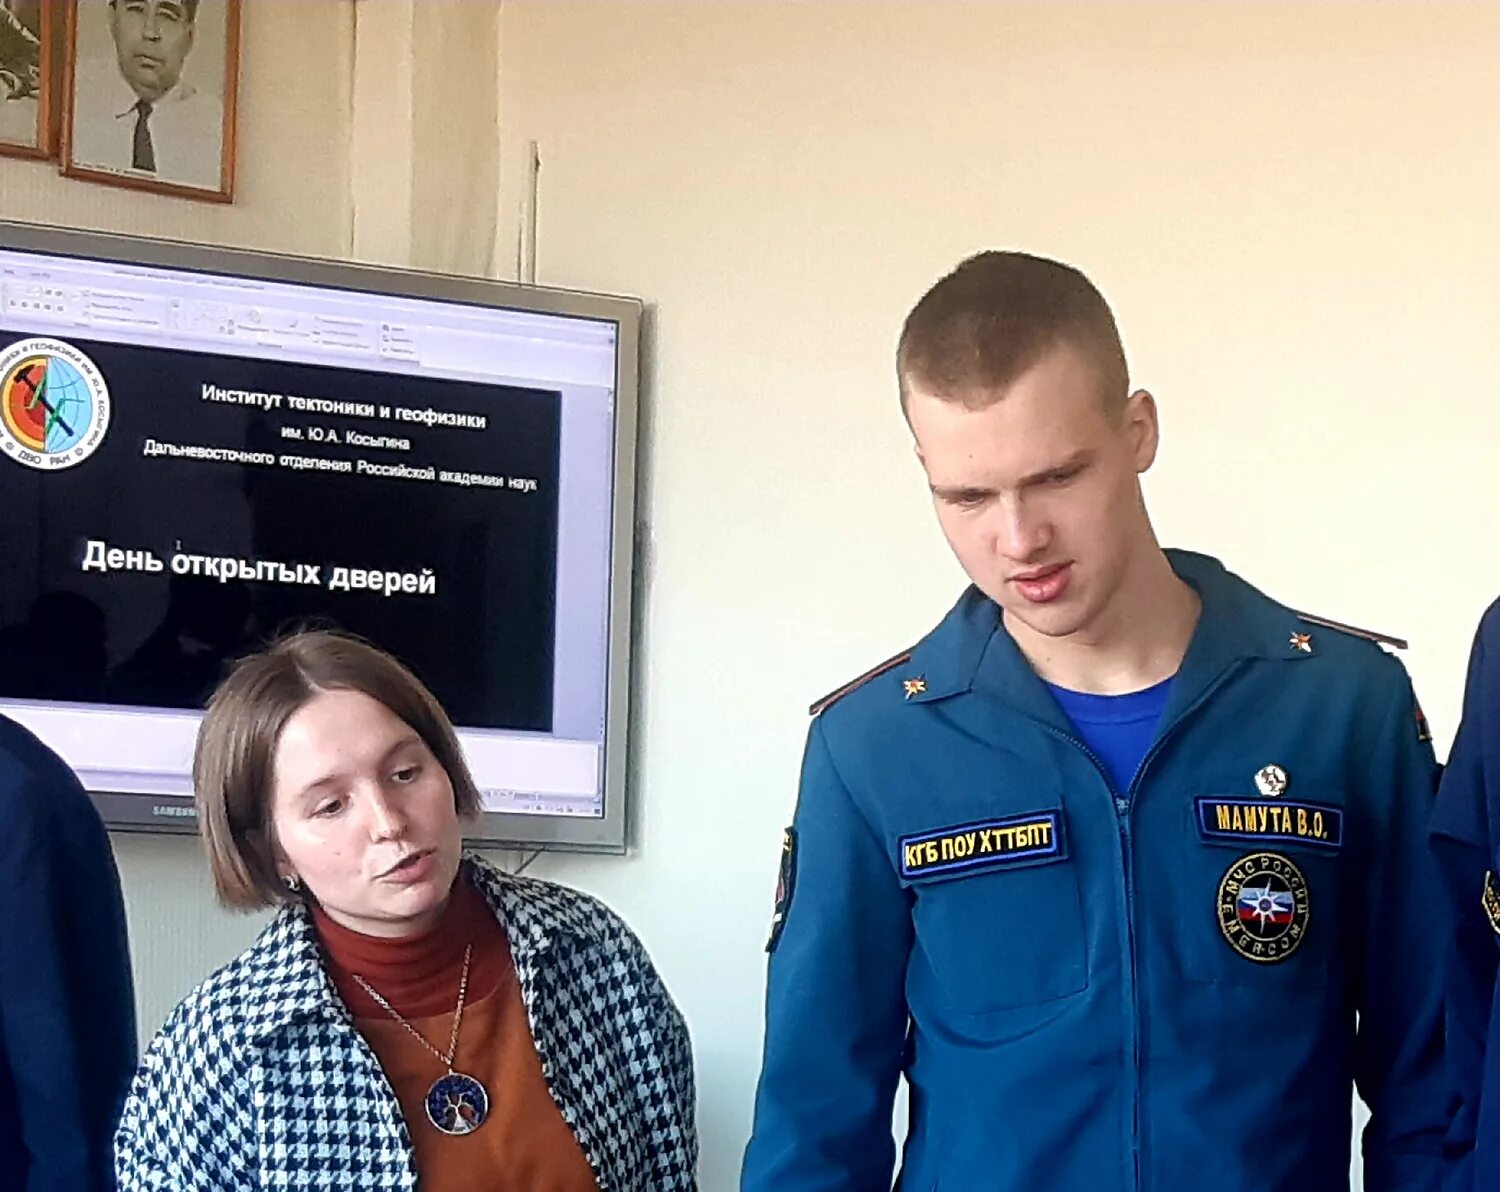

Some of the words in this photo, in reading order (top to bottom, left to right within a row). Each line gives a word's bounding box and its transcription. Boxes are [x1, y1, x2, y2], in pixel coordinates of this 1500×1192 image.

[202, 383, 284, 411] Институт
[287, 396, 375, 418] тектоники
[379, 405, 391, 418] и
[395, 407, 487, 429] геофизики
[281, 426, 304, 440] им.
[308, 426, 343, 444] Ю.А.
[345, 430, 411, 451] Косыгина
[143, 438, 275, 465] Дальневосточного
[279, 454, 352, 473] отделения
[356, 459, 435, 481] Российской
[439, 469, 504, 487] академии
[508, 475, 538, 493] наук
[82, 540, 164, 573] День
[172, 553, 321, 584] открытых
[329, 565, 436, 598] дверей
[905, 841, 939, 868] КГБ
[942, 831, 976, 861] ПОУ
[980, 821, 1053, 853] ХТТБПТ
[1216, 804, 1293, 834] МАМУТА
[1297, 808, 1329, 840] В.О.
[1226, 861, 1256, 894] МЧС
[1261, 857, 1307, 914] РОССИИ
